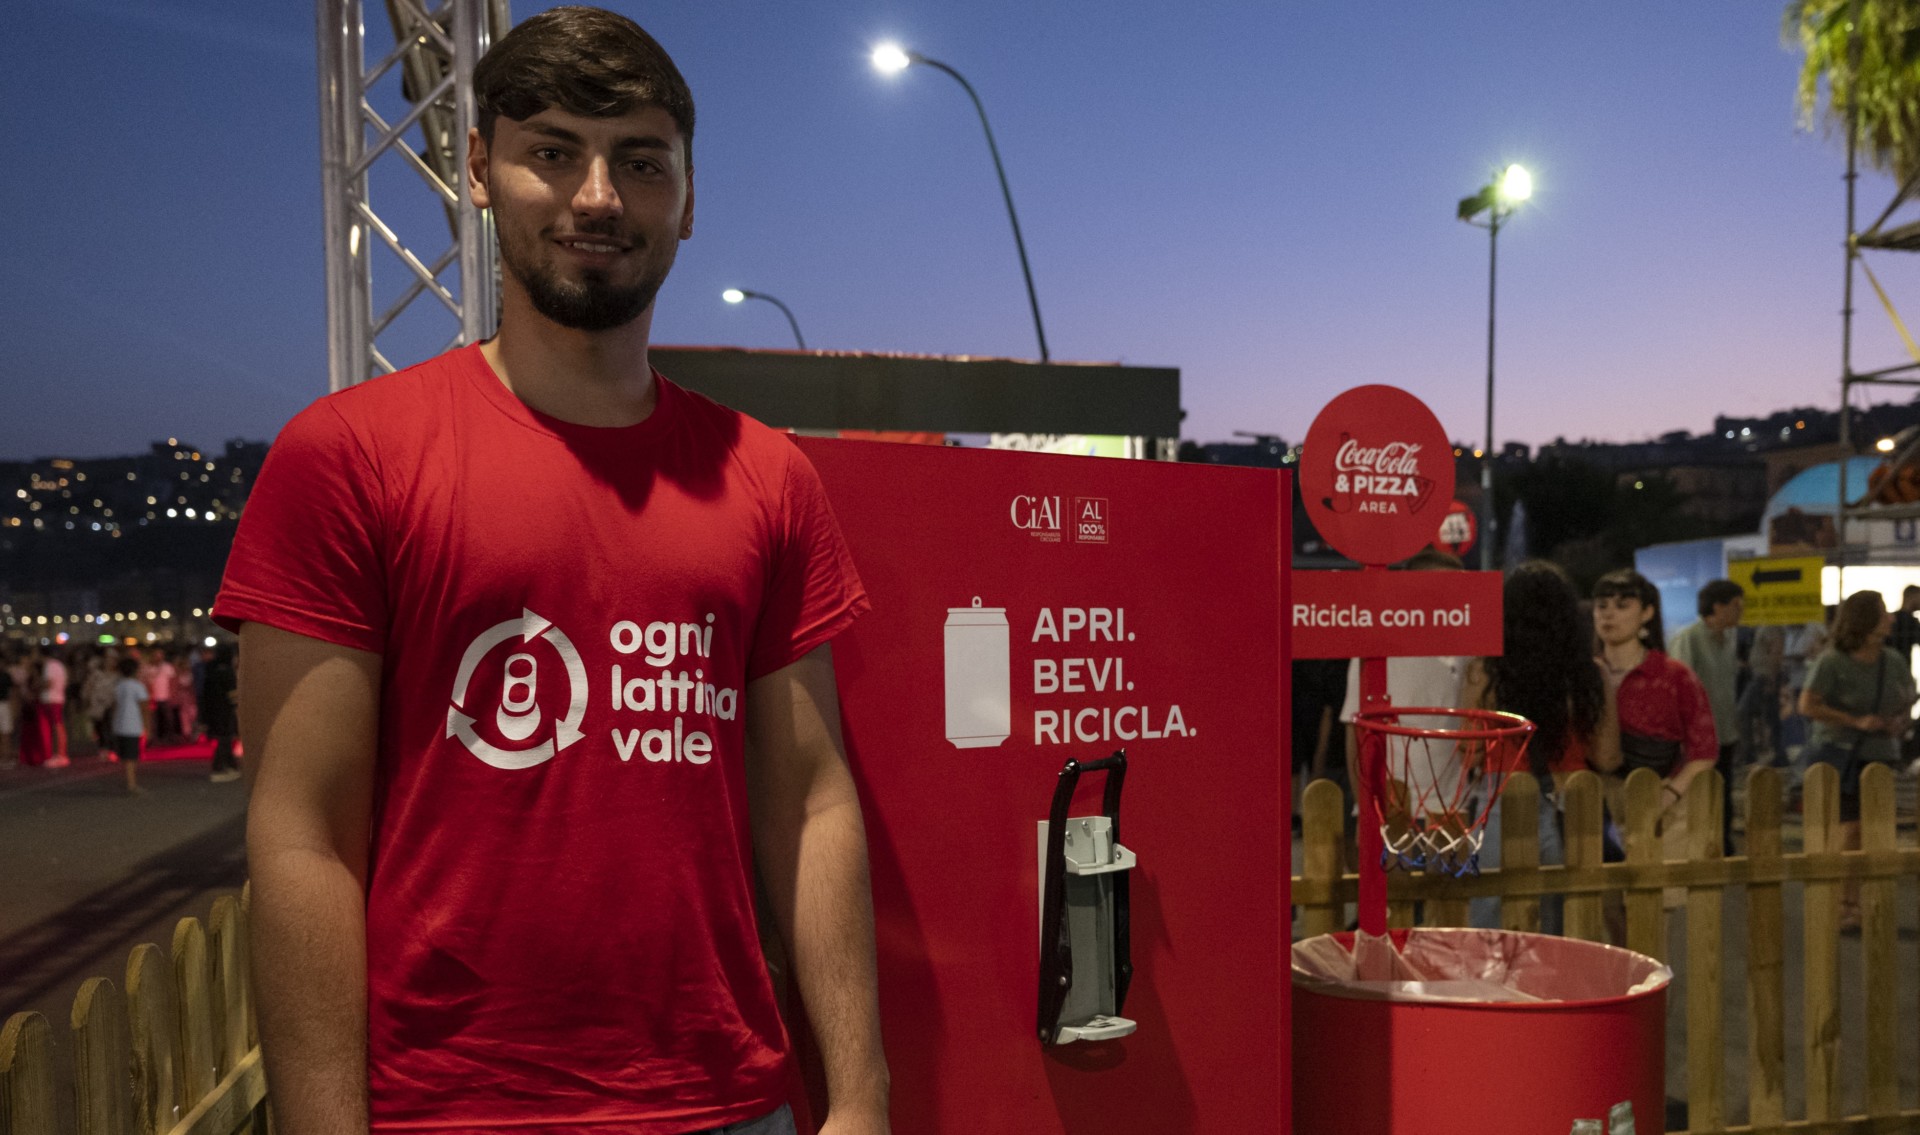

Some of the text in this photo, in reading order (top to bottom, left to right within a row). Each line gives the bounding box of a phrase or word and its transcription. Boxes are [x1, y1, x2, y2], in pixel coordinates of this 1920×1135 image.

[1335, 439, 1422, 475] Coca-Cola
[1335, 474, 1419, 497] & PIZZA
[1081, 500, 1103, 520] AL
[1359, 501, 1398, 514] AREA
[1031, 607, 1136, 643] APRI.
[1292, 603, 1470, 627] Ricicla con noi
[609, 613, 715, 667] ogni
[611, 664, 738, 721] lattina
[1033, 657, 1135, 694] BEVI.
[611, 716, 713, 765] vale
[1034, 704, 1197, 746] RICICLA.
